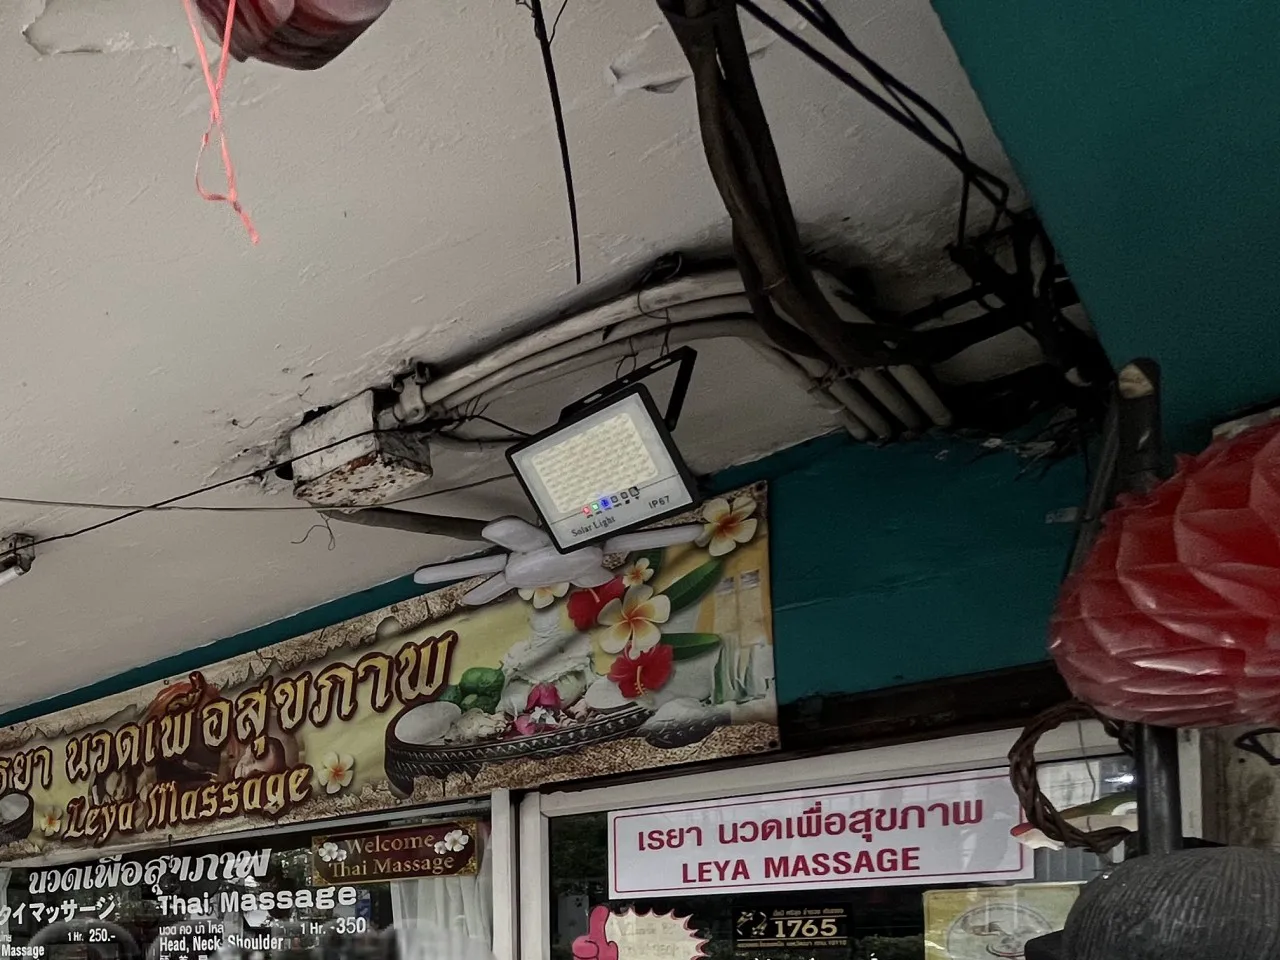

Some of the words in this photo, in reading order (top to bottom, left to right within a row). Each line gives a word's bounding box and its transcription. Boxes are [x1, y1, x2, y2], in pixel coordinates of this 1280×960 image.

[648, 495, 670, 510] IP67
[571, 522, 593, 538] Solar
[593, 515, 617, 531] Light
[65, 630, 458, 787] นวดเพื่อสุขภาพ
[62, 795, 136, 841] Leya
[144, 763, 314, 830] Massage
[637, 825, 702, 852] เรยา
[718, 799, 984, 846] นวดเพื่อสุขภาพ
[344, 834, 434, 854] Welcome
[329, 861, 367, 878] Thai
[373, 855, 455, 874] Massage
[681, 860, 750, 884] LEYA
[763, 846, 920, 879] MASSAGE
[157, 892, 217, 916] Thai
[220, 885, 357, 915] Massage
[73, 932, 84, 942] Hr.
[89, 928, 116, 942] 250.-
[300, 923, 305, 934] 1
[310, 922, 326, 934] Hr.
[774, 918, 838, 938] 1765
[1, 944, 45, 958] Massage
[159, 936, 189, 953] Head,
[228, 934, 284, 951] Shoulder
